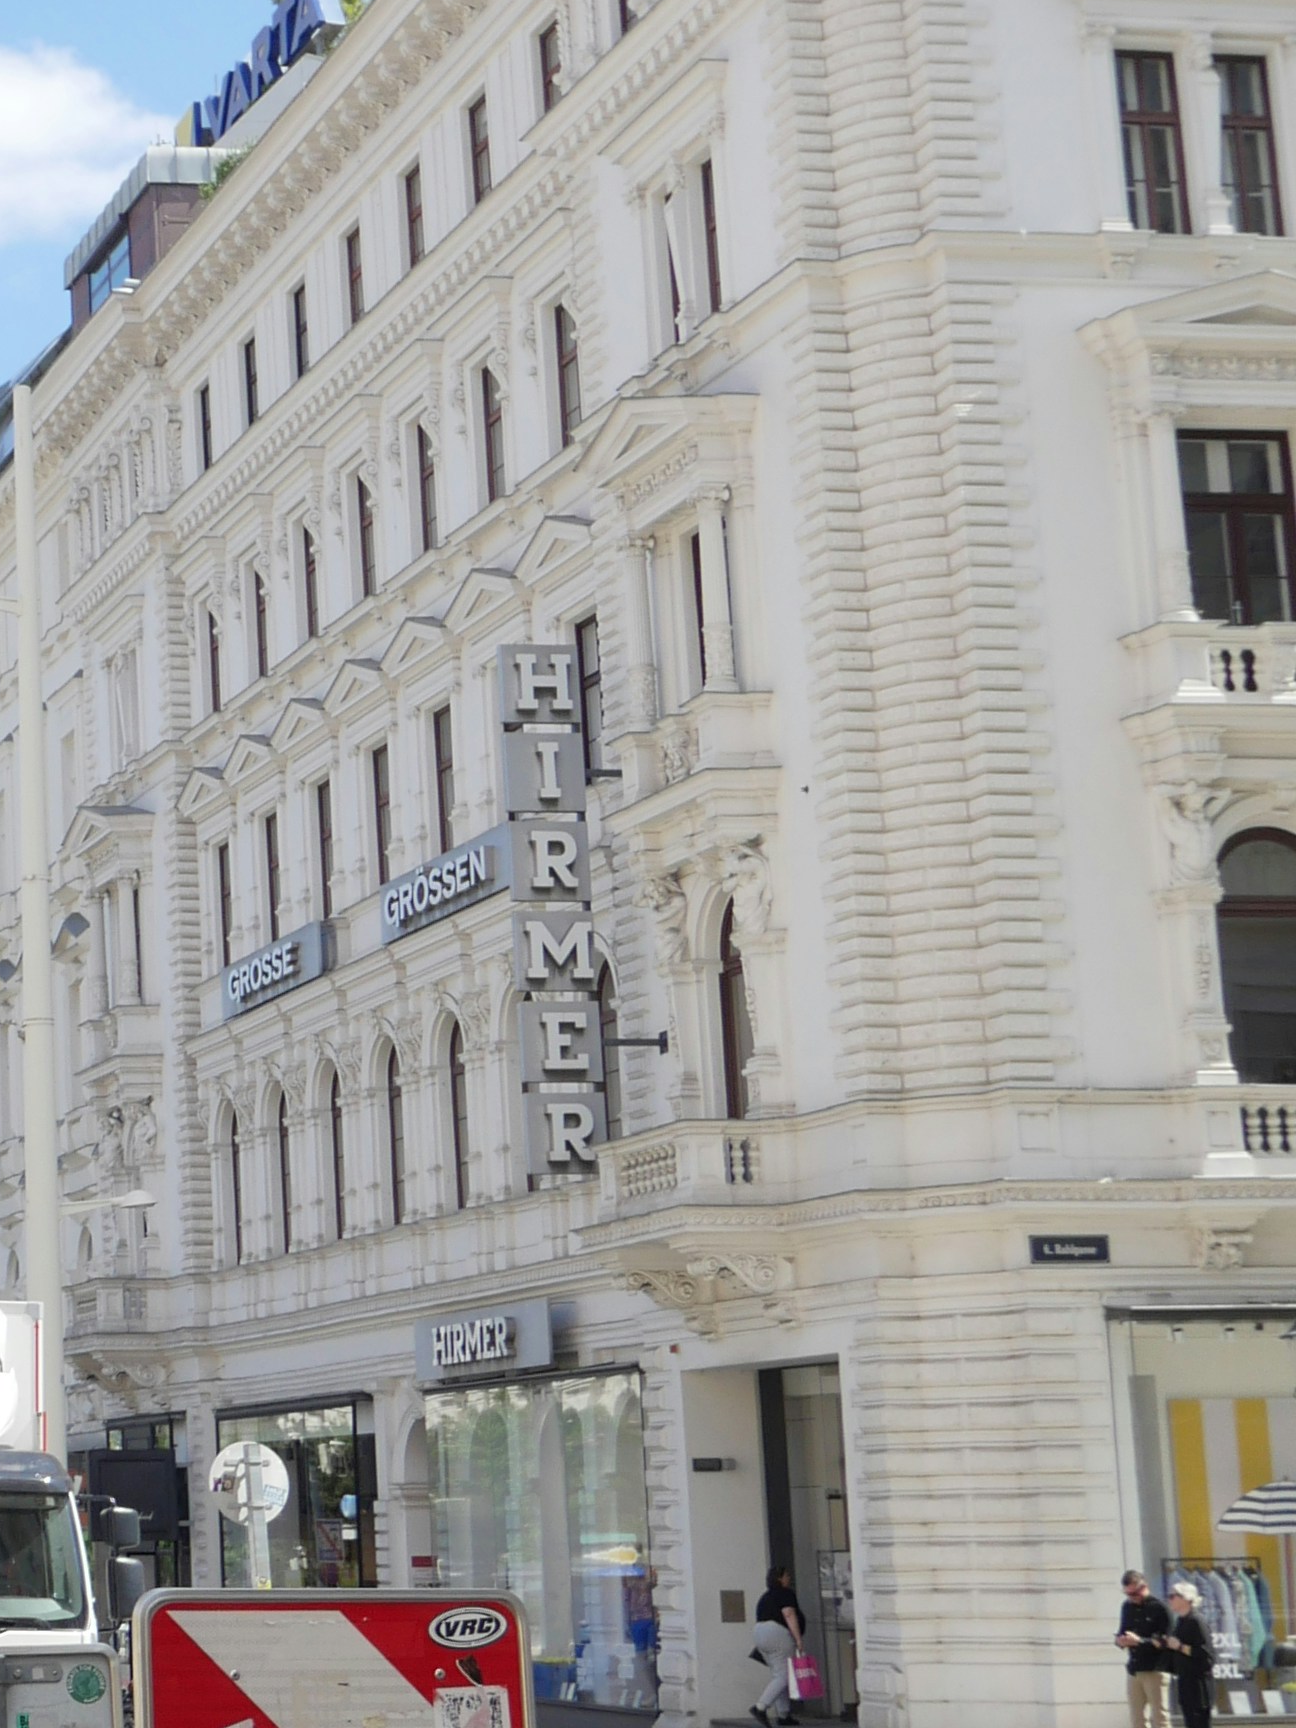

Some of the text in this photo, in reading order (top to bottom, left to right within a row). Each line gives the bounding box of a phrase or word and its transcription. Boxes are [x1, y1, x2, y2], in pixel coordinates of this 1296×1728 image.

[384, 845, 486, 927] GRÖSSEN
[514, 652, 597, 1163] HIRMER
[228, 942, 293, 1004] GROSSE
[432, 1316, 508, 1366] HIRMER
[442, 1619, 494, 1636] VRC
